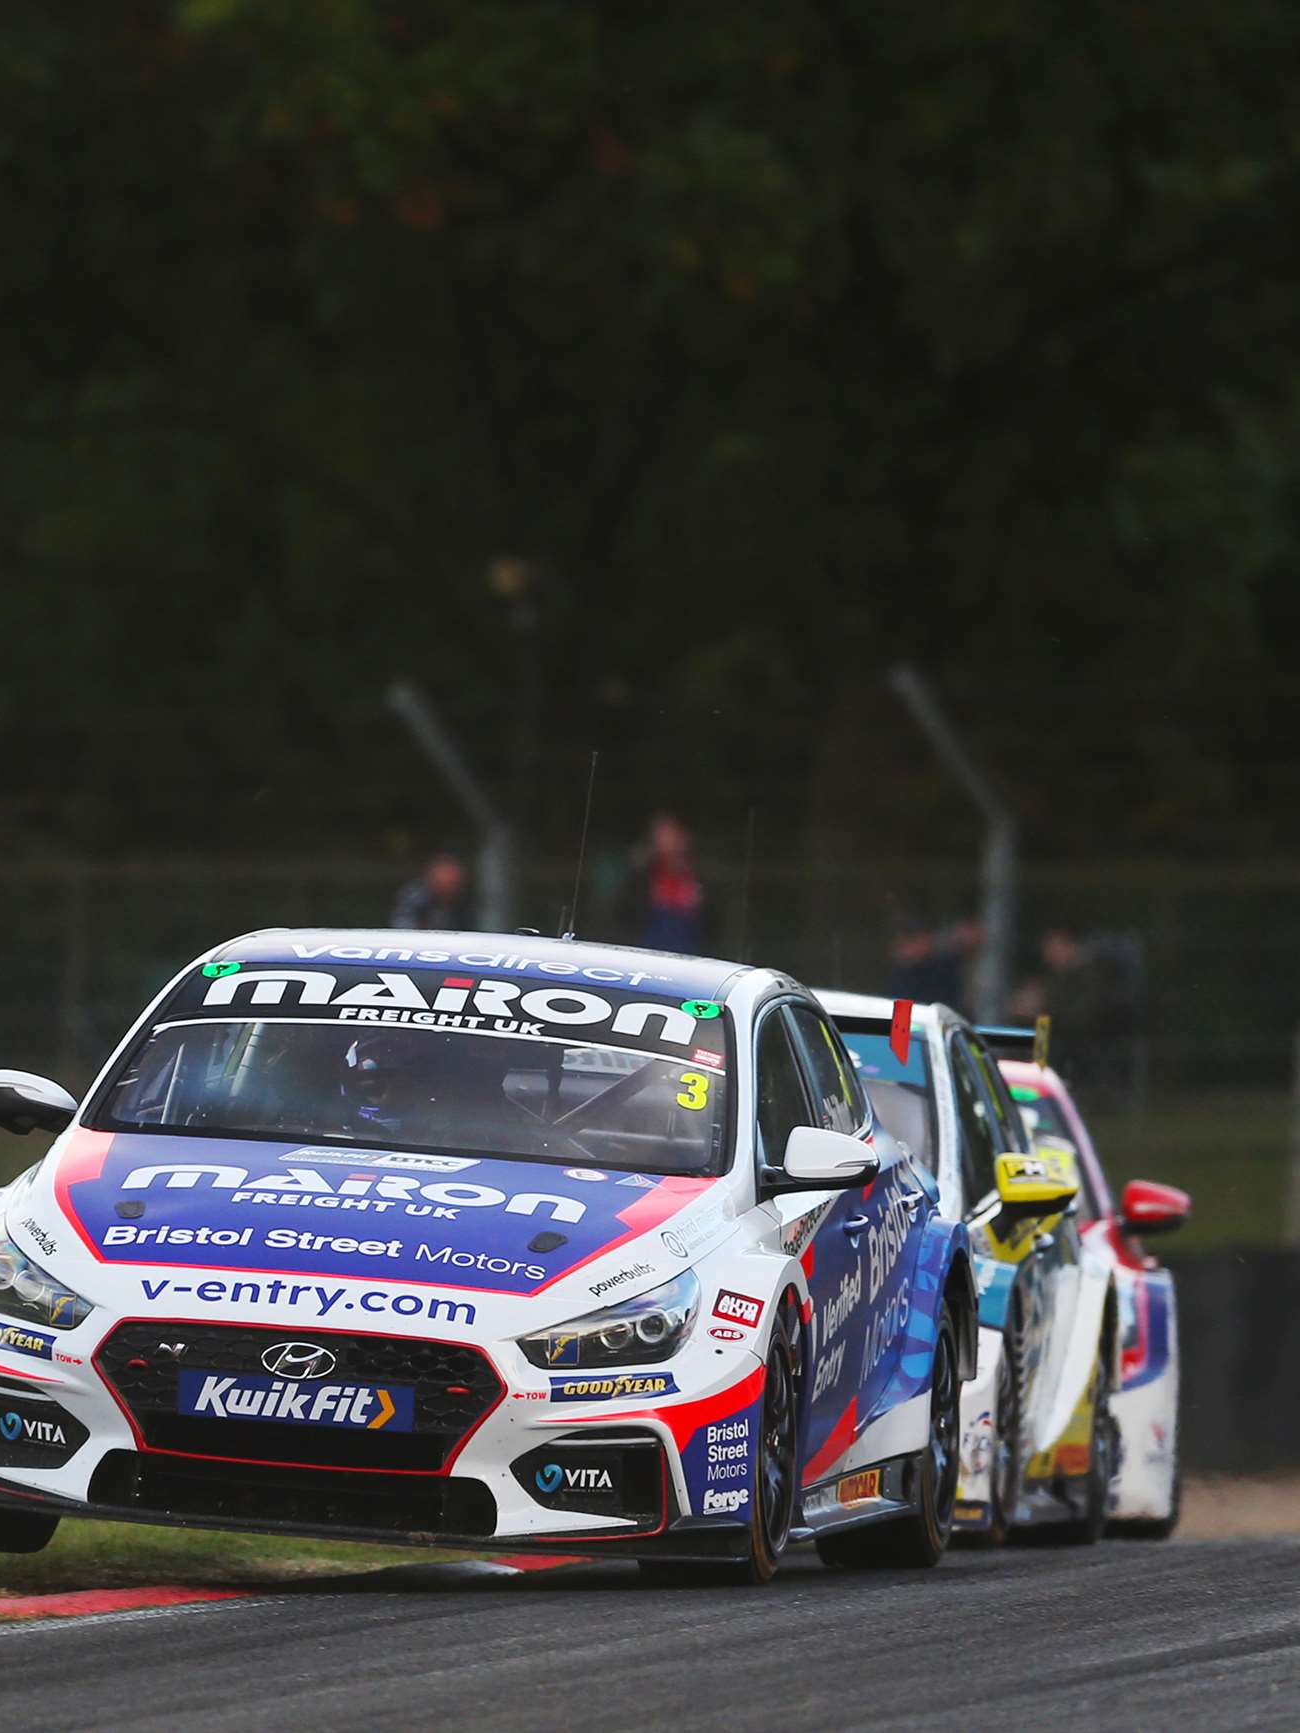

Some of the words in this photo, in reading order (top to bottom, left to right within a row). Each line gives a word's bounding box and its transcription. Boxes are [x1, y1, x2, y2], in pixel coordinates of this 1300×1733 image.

[338, 1007, 488, 1030] FREIGHT
[494, 1019, 546, 1036] UK
[676, 1072, 710, 1111] 3
[230, 1191, 399, 1214] FREIGHT
[404, 1203, 460, 1221] UK
[103, 1224, 254, 1248] Bristol
[266, 1226, 404, 1257] Street
[415, 1243, 547, 1281] Motors
[589, 1262, 656, 1297] powerbulbs
[141, 1279, 477, 1326] v-entry.com
[823, 1255, 861, 1347] Verified
[714, 1329, 741, 1339] ABS
[55, 1353, 72, 1364] TOW
[811, 1340, 847, 1404] Entry
[525, 1391, 547, 1400] TOW
[563, 1375, 667, 1398] GOODYEAR
[23, 1418, 67, 1445] VITA
[706, 1418, 749, 1444] Bristol
[706, 1441, 749, 1463] Street
[564, 1468, 613, 1488] VITA
[706, 1462, 748, 1482] Motors
